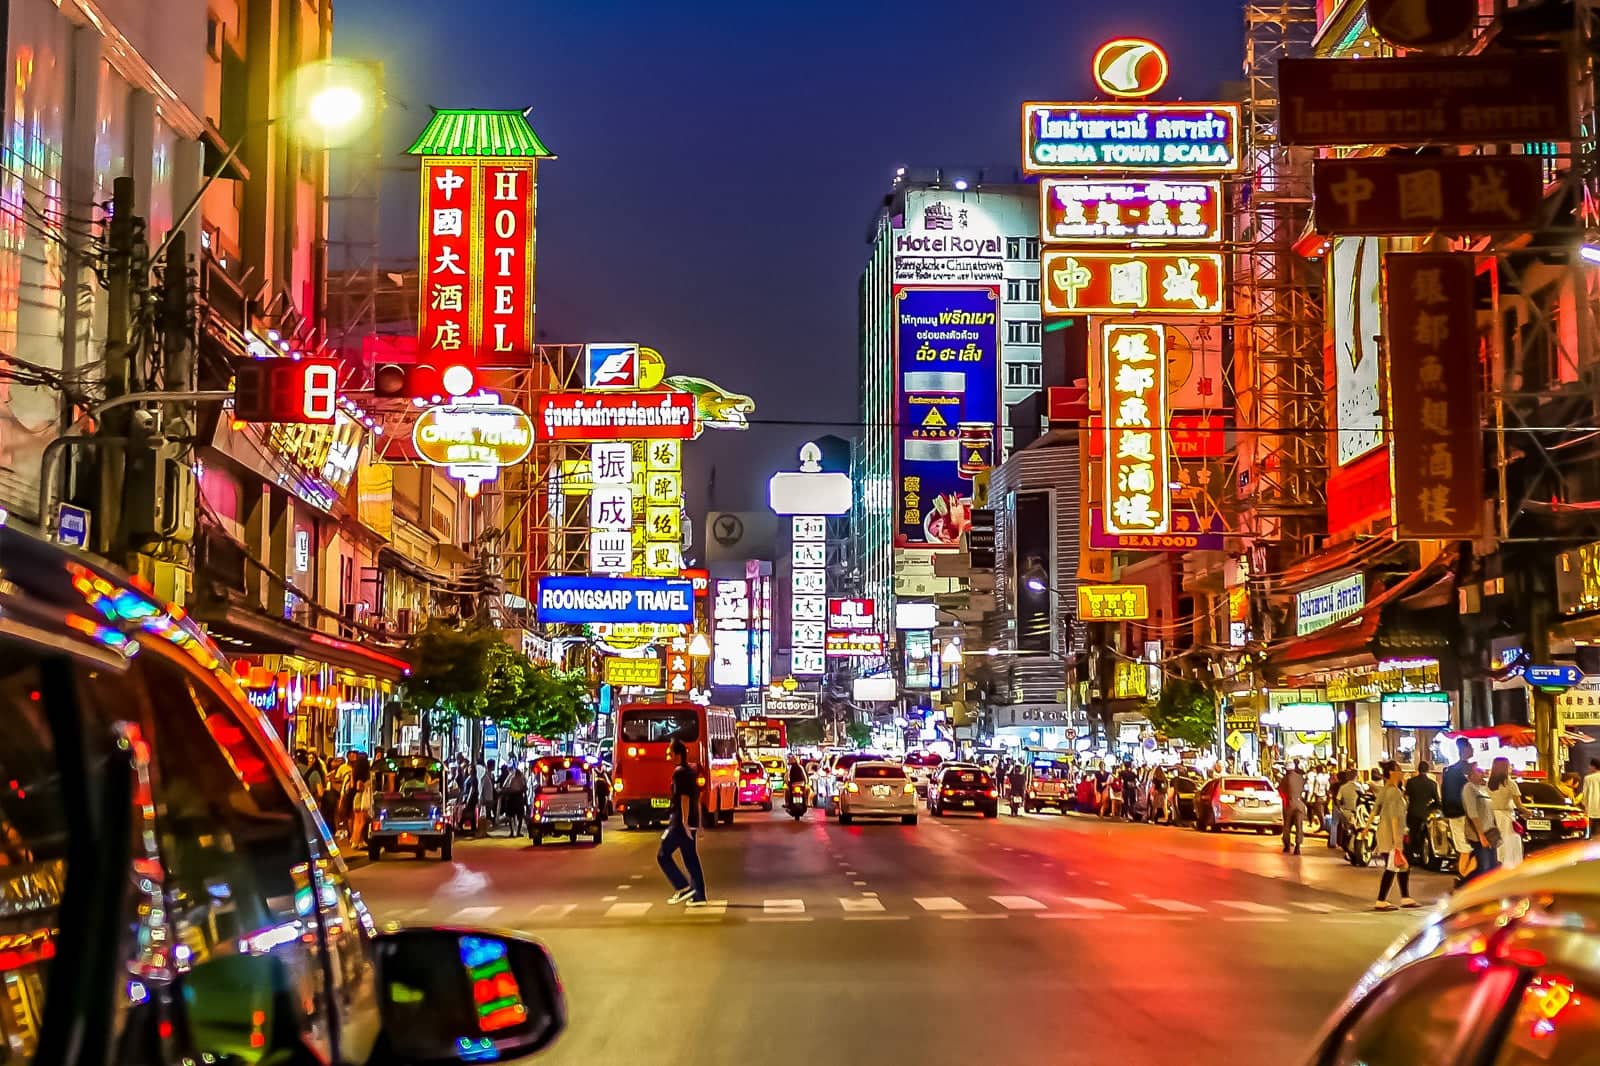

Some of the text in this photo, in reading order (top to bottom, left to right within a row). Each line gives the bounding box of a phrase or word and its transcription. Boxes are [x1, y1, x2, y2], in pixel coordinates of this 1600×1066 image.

[1036, 144, 1228, 162] CHINA TOWN SCALA
[897, 235, 1000, 255] Hotel Royal
[431, 169, 466, 351] 中國大酒店
[493, 172, 518, 351] HOTEL
[947, 259, 1003, 271] Chinatown
[1053, 257, 1207, 309] 中國城
[303, 364, 337, 419] 8
[1118, 535, 1197, 547] SEAFOOD
[542, 589, 689, 611] ROONGSARP TRAVEL
[1568, 670, 1576, 681] 2
